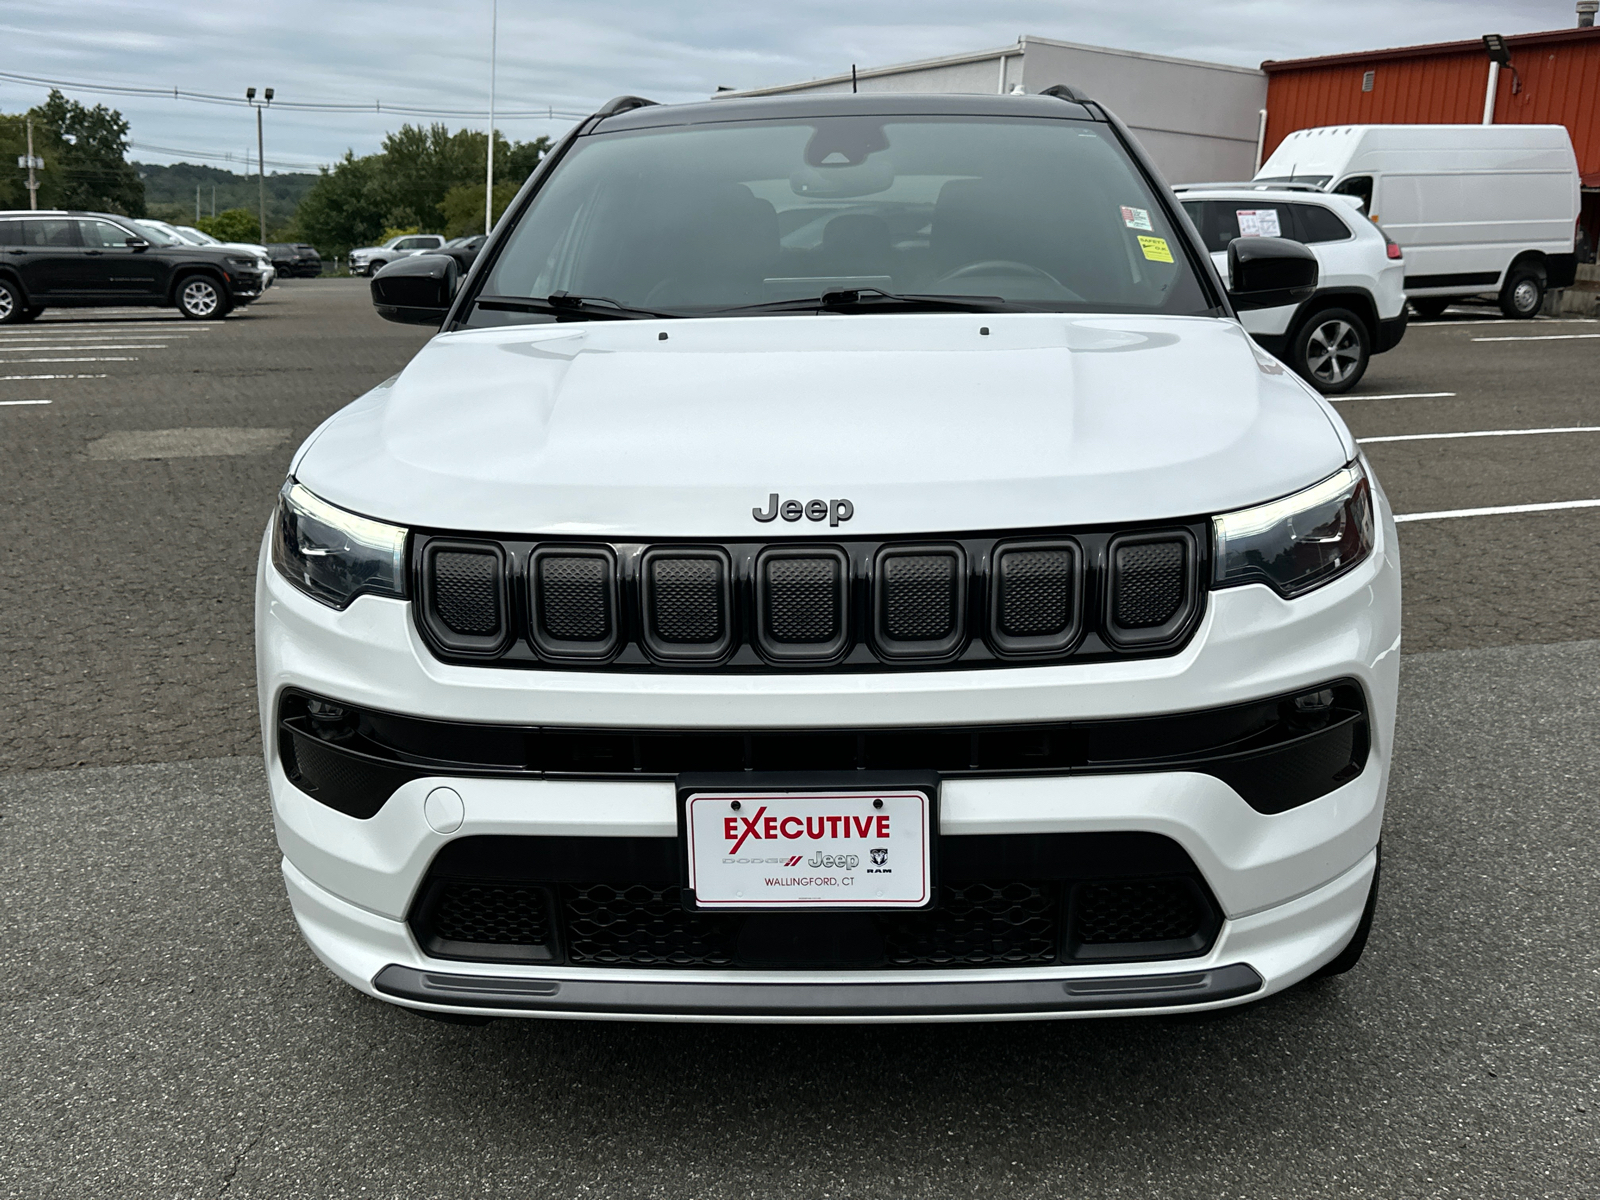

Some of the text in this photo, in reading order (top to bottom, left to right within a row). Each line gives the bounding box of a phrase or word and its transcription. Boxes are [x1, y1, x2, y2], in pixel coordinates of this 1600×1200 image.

[752, 493, 854, 527] Jeep
[724, 806, 890, 854] EXECUTIVE
[808, 851, 860, 870] Jeep
[764, 877, 855, 887] WALLINGFORD, CT
